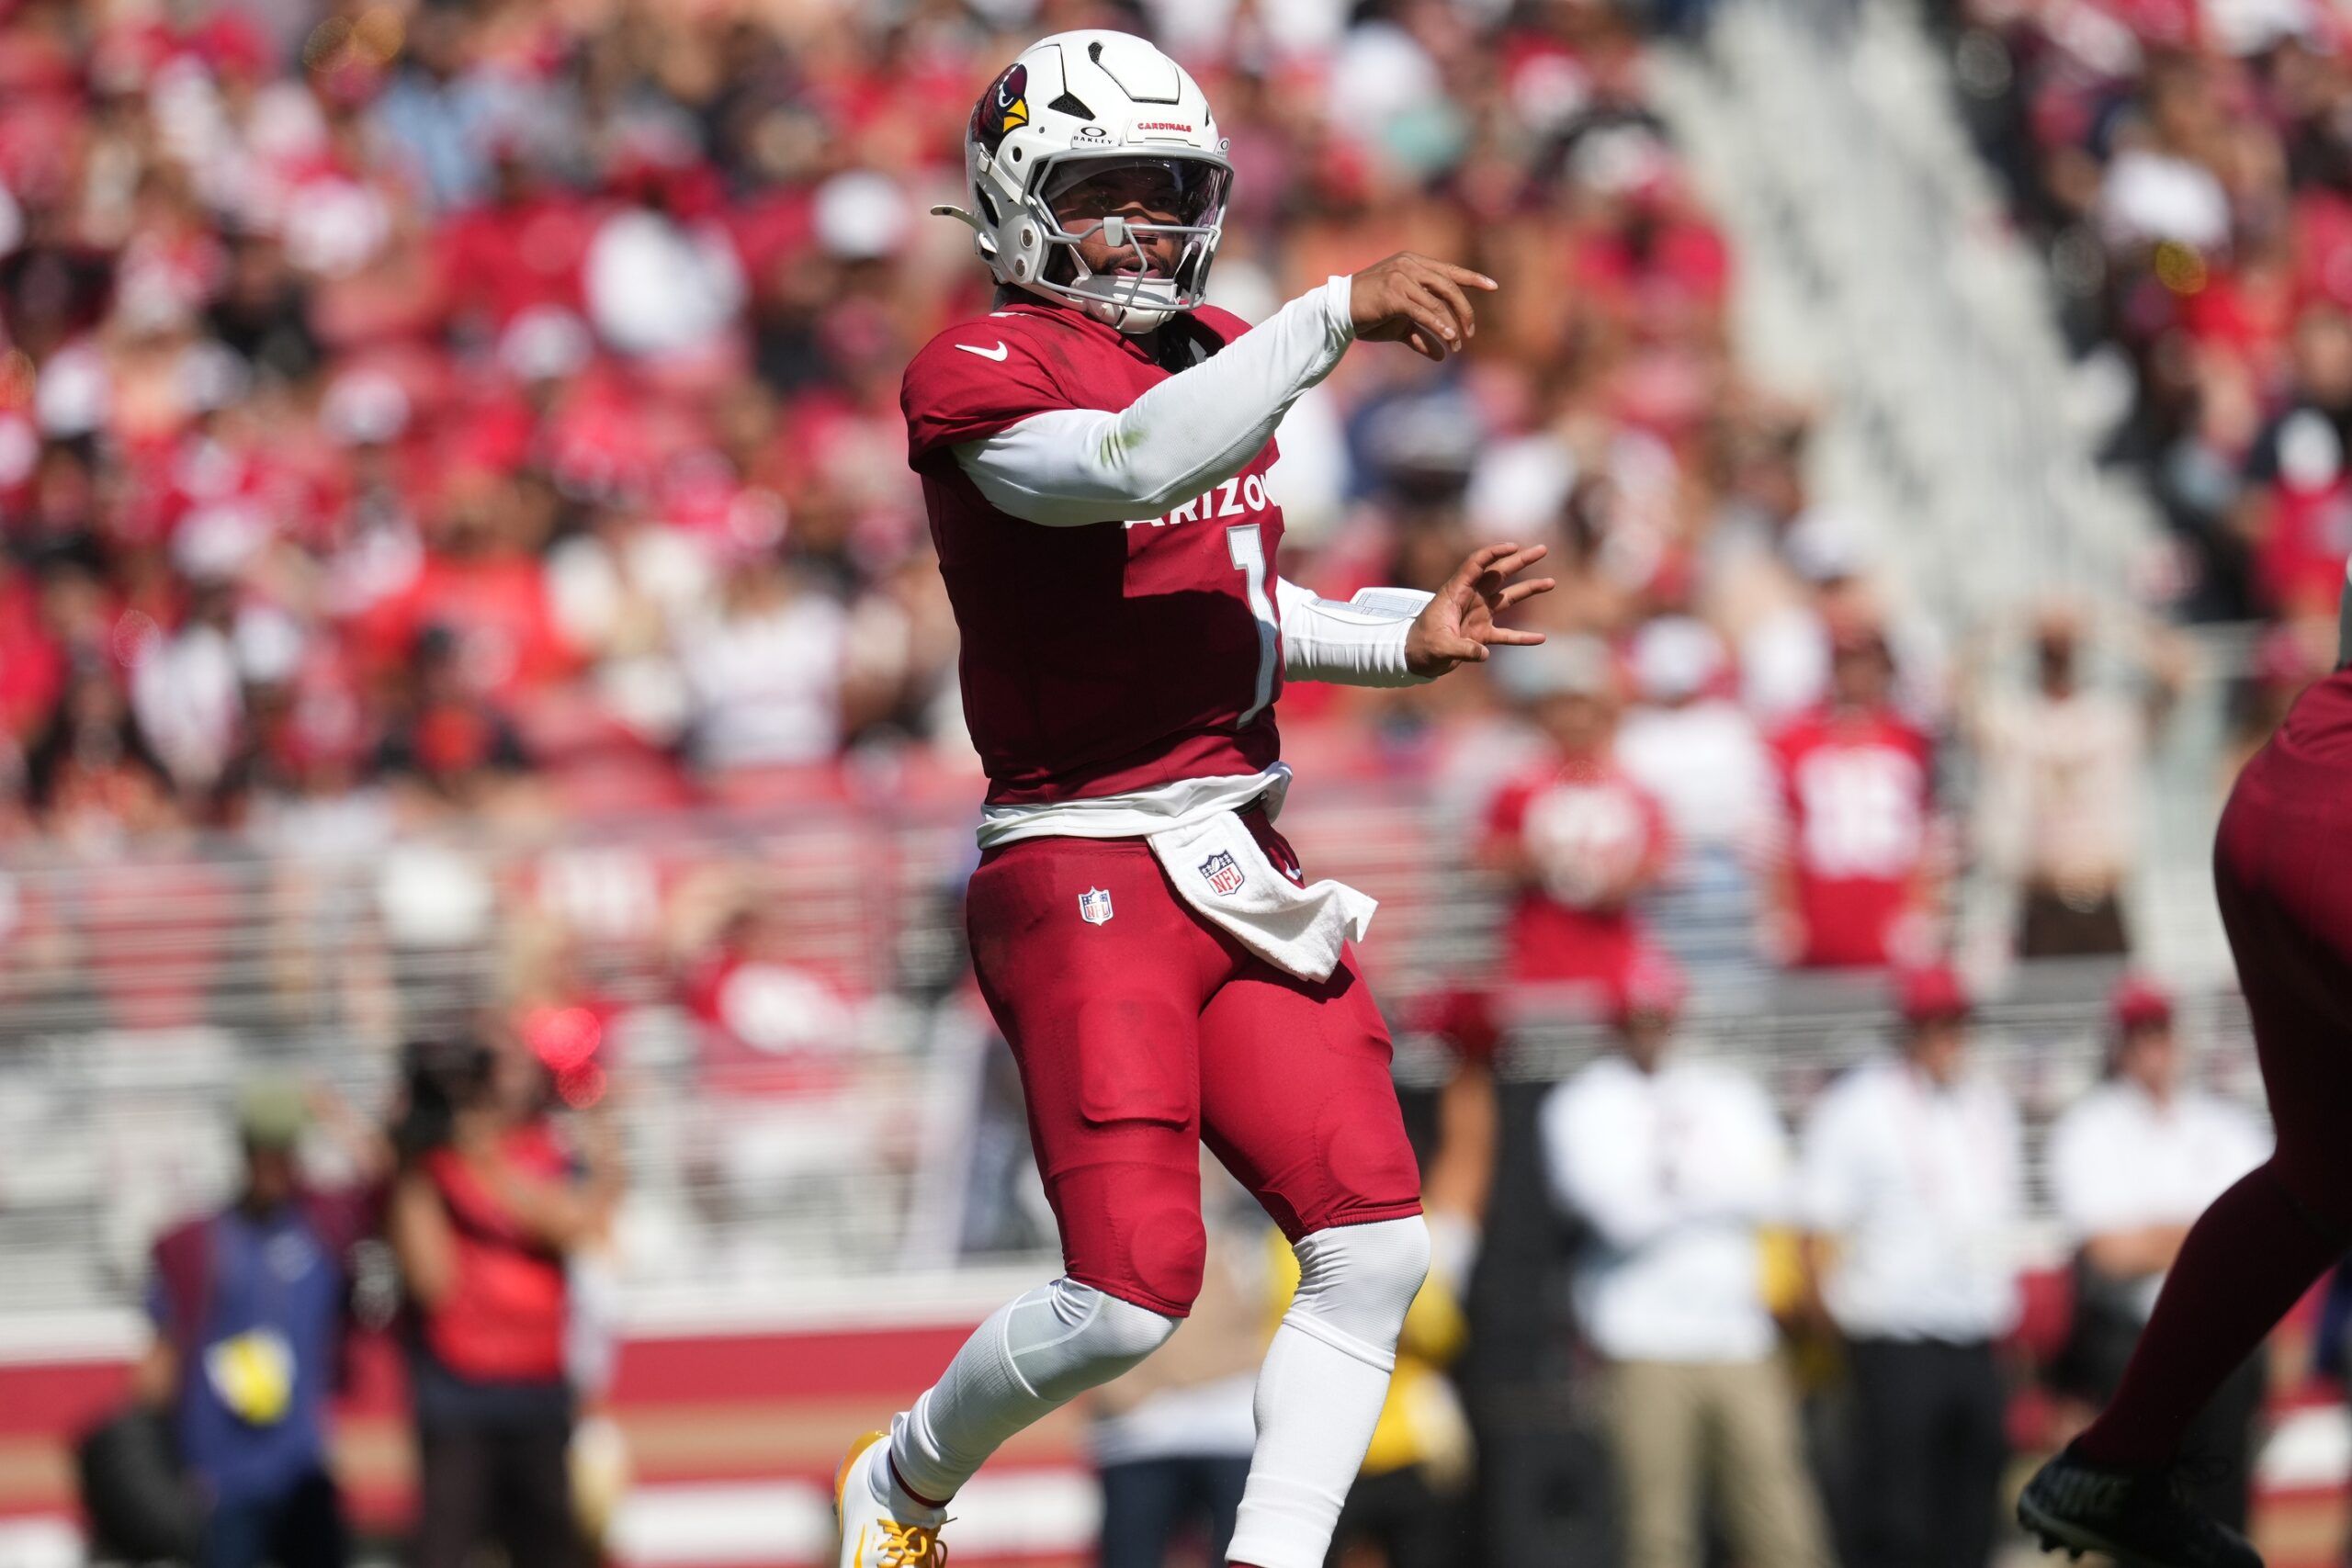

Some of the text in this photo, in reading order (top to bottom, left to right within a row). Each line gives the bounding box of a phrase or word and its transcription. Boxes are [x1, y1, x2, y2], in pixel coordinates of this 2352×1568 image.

[1136, 122, 1192, 132] CARDINALS
[1073, 135, 1112, 144] OAKLEY
[1227, 523, 1280, 730] 1
[1210, 866, 1241, 893] NFL
[1086, 905, 1109, 918] NFL
